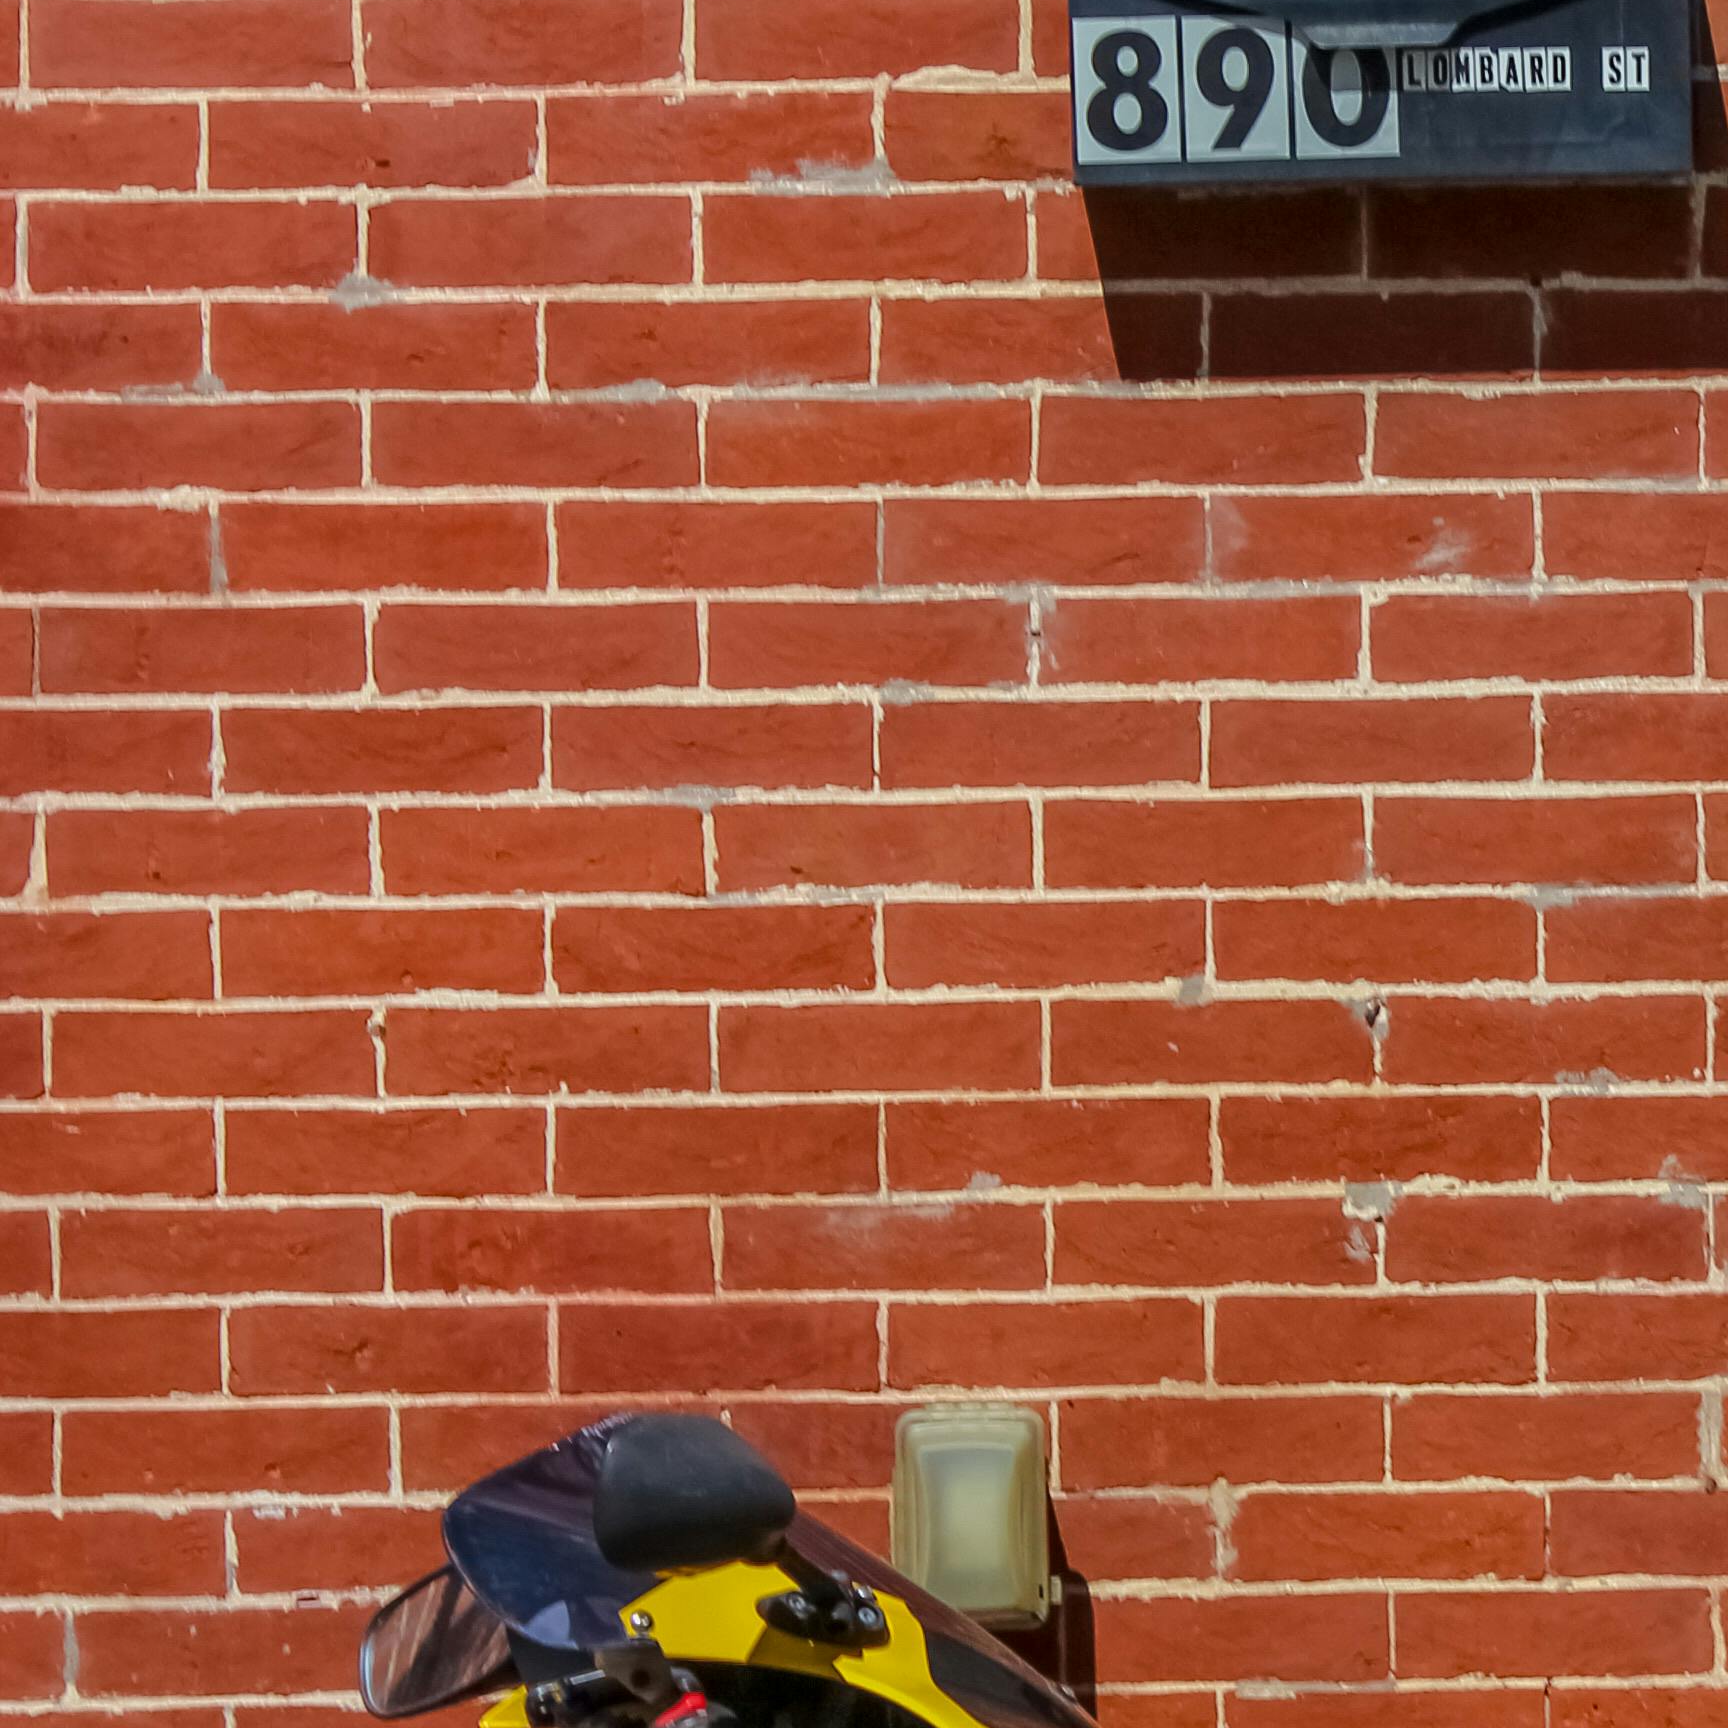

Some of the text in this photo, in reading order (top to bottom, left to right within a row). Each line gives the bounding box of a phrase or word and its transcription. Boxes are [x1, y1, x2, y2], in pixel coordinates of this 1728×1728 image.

[1086, 27, 1647, 152] 890 LOMBARD ST
